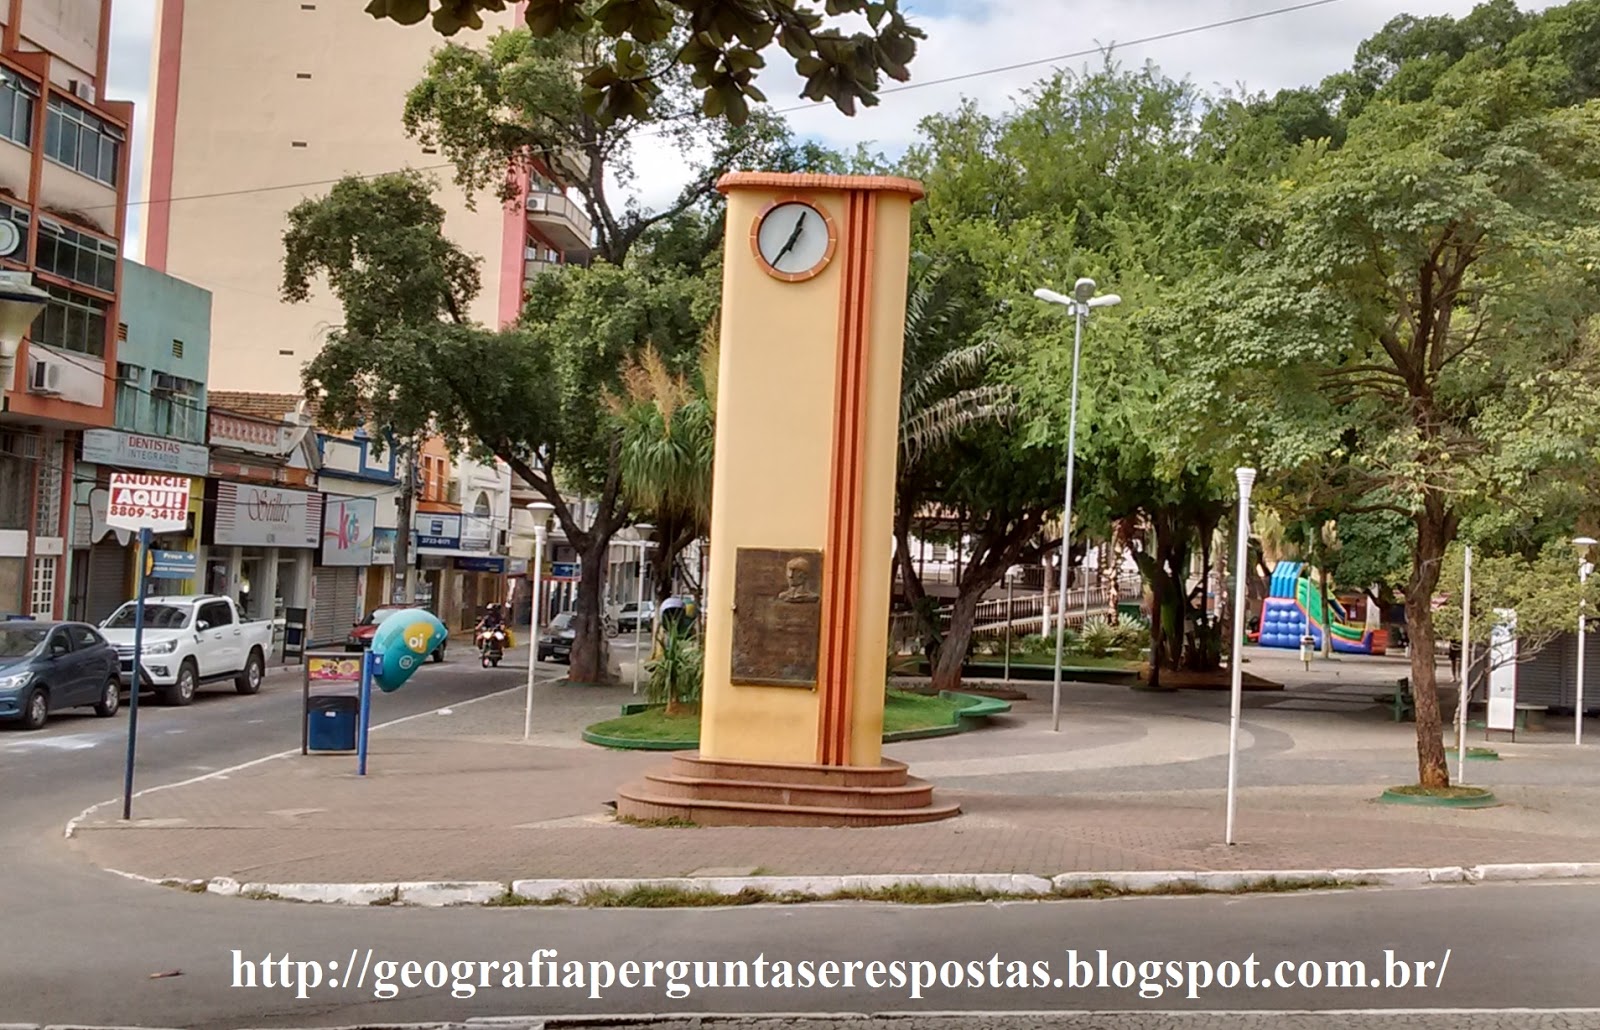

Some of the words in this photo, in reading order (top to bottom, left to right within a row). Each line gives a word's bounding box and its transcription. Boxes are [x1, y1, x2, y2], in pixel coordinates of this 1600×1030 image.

[128, 436, 180, 454] DENTISTAS
[113, 474, 188, 488] ANUNCIE
[115, 488, 183, 508] AQUI!
[110, 505, 186, 521] 8809-3418
[409, 633, 424, 648] oi
